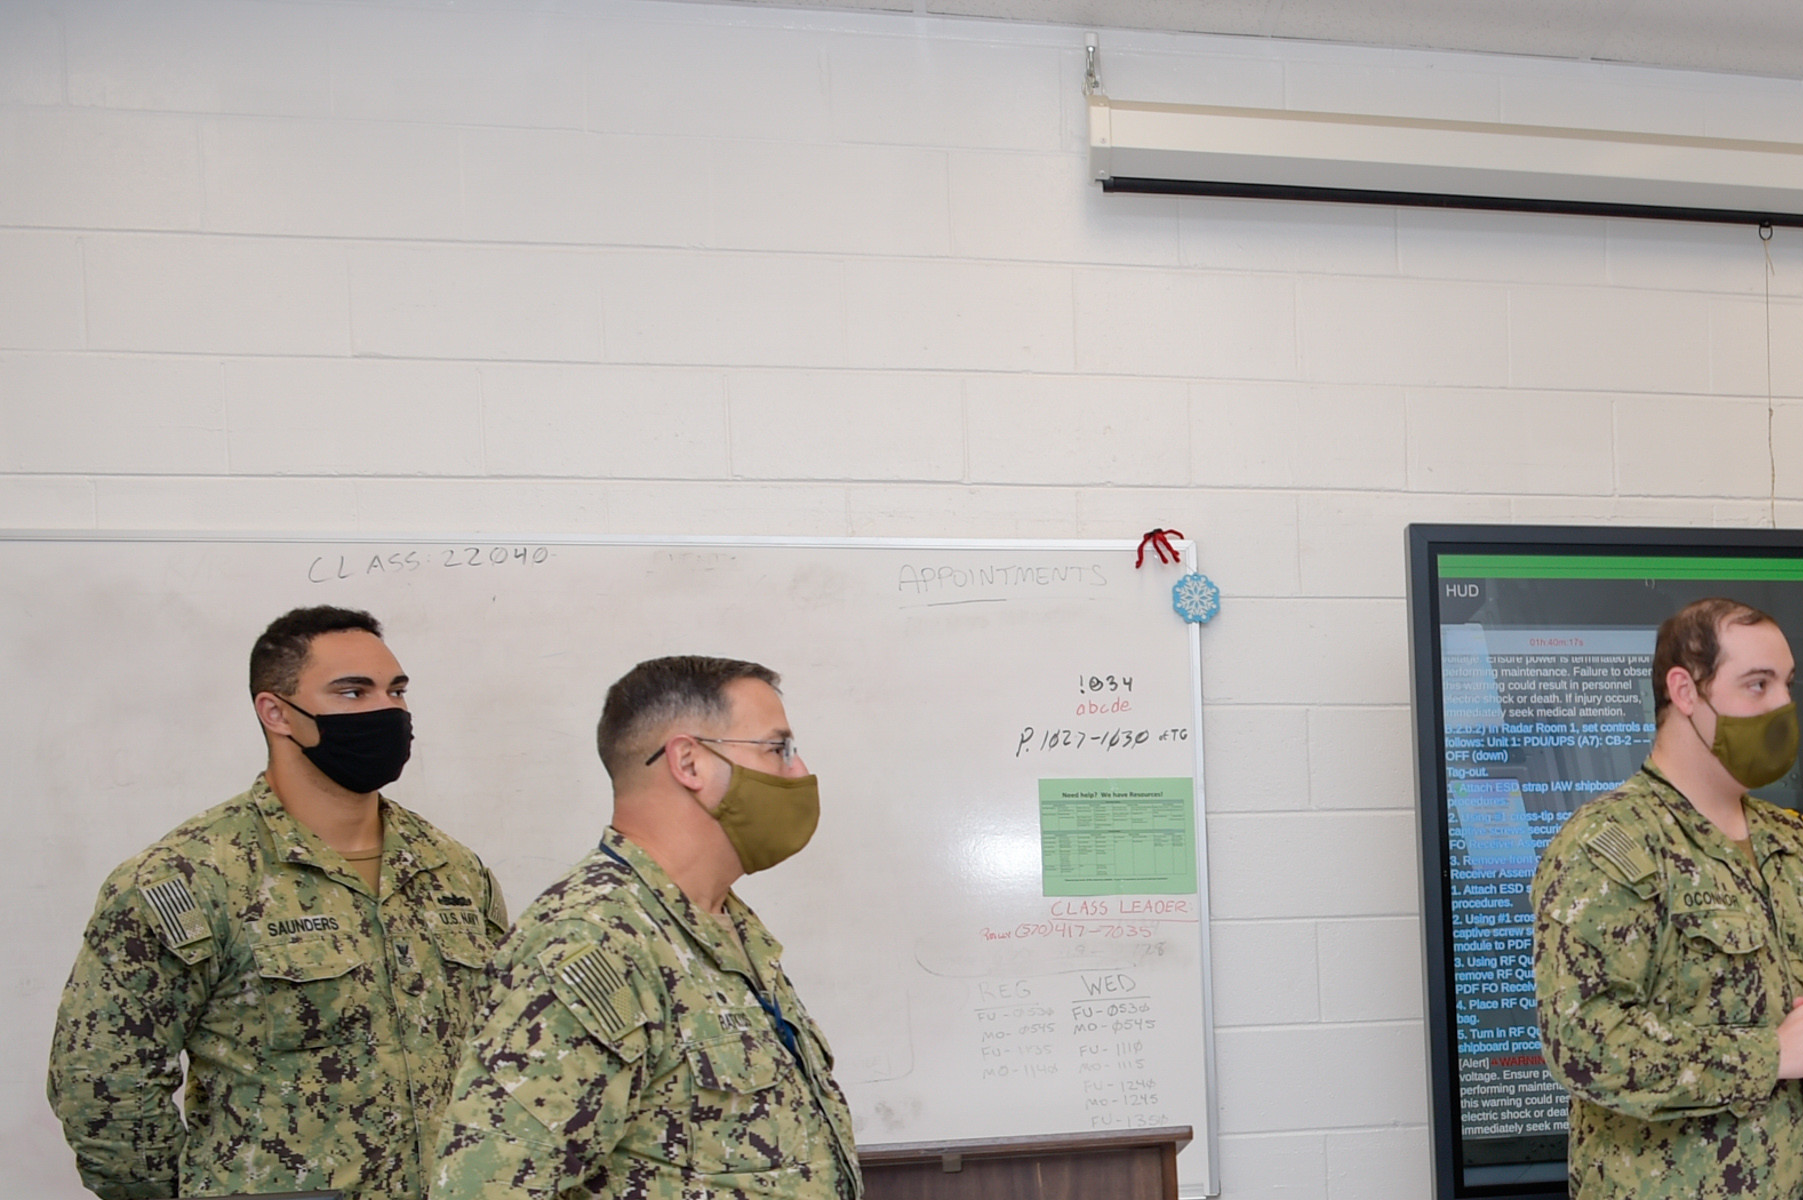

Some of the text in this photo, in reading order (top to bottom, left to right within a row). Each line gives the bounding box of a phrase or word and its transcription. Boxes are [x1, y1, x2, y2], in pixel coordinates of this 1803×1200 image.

[898, 564, 1107, 593] APPOINTMENTS
[1446, 584, 1479, 597] HUD
[1530, 638, 1583, 647] 01h:40m:17s
[1442, 666, 1652, 679] performing maintenance. Failure to obser
[1443, 680, 1631, 694] this warning could result in personnel
[1444, 693, 1641, 706] electric shock or death. If injury occurs,
[1076, 697, 1132, 716] abcde
[1444, 706, 1626, 719] immediately seek medical attention.
[1489, 722, 1655, 735] In Radar Room 1, set controls as
[1445, 737, 1484, 748] follows:
[1487, 737, 1509, 747] Unit
[1512, 737, 1521, 747] 1:
[1524, 736, 1574, 748] PDU/UPS
[1577, 736, 1602, 749] (A7):
[1605, 735, 1631, 746] CB-2
[1446, 750, 1508, 763] OFF (down)
[1447, 767, 1488, 778] Tag-out.
[1459, 783, 1492, 793] Attach
[1496, 783, 1518, 792] ESD
[1522, 783, 1548, 795] strap
[1551, 781, 1572, 791] IAW
[1062, 790, 1164, 802] Need help? We have Resources!
[1448, 813, 1458, 823] 2.
[1462, 813, 1489, 825] Using
[1510, 811, 1554, 824] cross-tip
[1449, 825, 1565, 838] captive screws securi
[1450, 838, 1550, 850] FO Receiver Assem
[1450, 856, 1459, 865] 3.
[1463, 855, 1506, 865] Remove
[1509, 854, 1533, 864] front
[1451, 869, 1496, 879] Receiver
[1452, 886, 1461, 895] 1.
[1463, 884, 1496, 895] Attach
[1499, 884, 1524, 893] ESD
[1452, 897, 1513, 911] procedures.
[1683, 891, 1739, 907] OCONNOR
[1051, 900, 1109, 917] CLASS
[439, 912, 481, 927] U.S. NAVY
[1453, 913, 1511, 926] 2. Using #1
[267, 917, 340, 937] SAUNDERS
[1453, 926, 1490, 939] captive
[1493, 927, 1523, 937] screw
[1454, 939, 1532, 952] module to PDF
[1454, 957, 1465, 967] 3.
[1467, 956, 1497, 969] Using
[1500, 955, 1516, 965] RF
[1455, 971, 1494, 981] remove
[1497, 969, 1513, 979] RF
[978, 980, 1032, 1003] REG
[1080, 973, 1137, 997] WED
[1456, 984, 1479, 994] PDF
[1482, 983, 1499, 993] FO
[1456, 1000, 1466, 1010] 4.
[1469, 999, 1499, 1010] Place
[1501, 998, 1517, 1008] RF
[1457, 1013, 1479, 1025] bag.
[1458, 1029, 1467, 1039] 5.
[1470, 1028, 1494, 1039] Turn
[1496, 1027, 1506, 1038] in
[1509, 1027, 1525, 1037] RF
[1458, 1041, 1509, 1056] shipboard
[1459, 1057, 1489, 1072] [Alert]
[1459, 1071, 1500, 1083] voltage.
[1503, 1069, 1539, 1080] Ensure
[1460, 1084, 1515, 1097] performing
[1461, 1096, 1479, 1108] this
[1482, 1096, 1522, 1110] warning
[1525, 1094, 1553, 1105] could
[1461, 1107, 1545, 1121] electric shock or
[1462, 1122, 1523, 1136] immediately
[1526, 1120, 1551, 1132] seek
